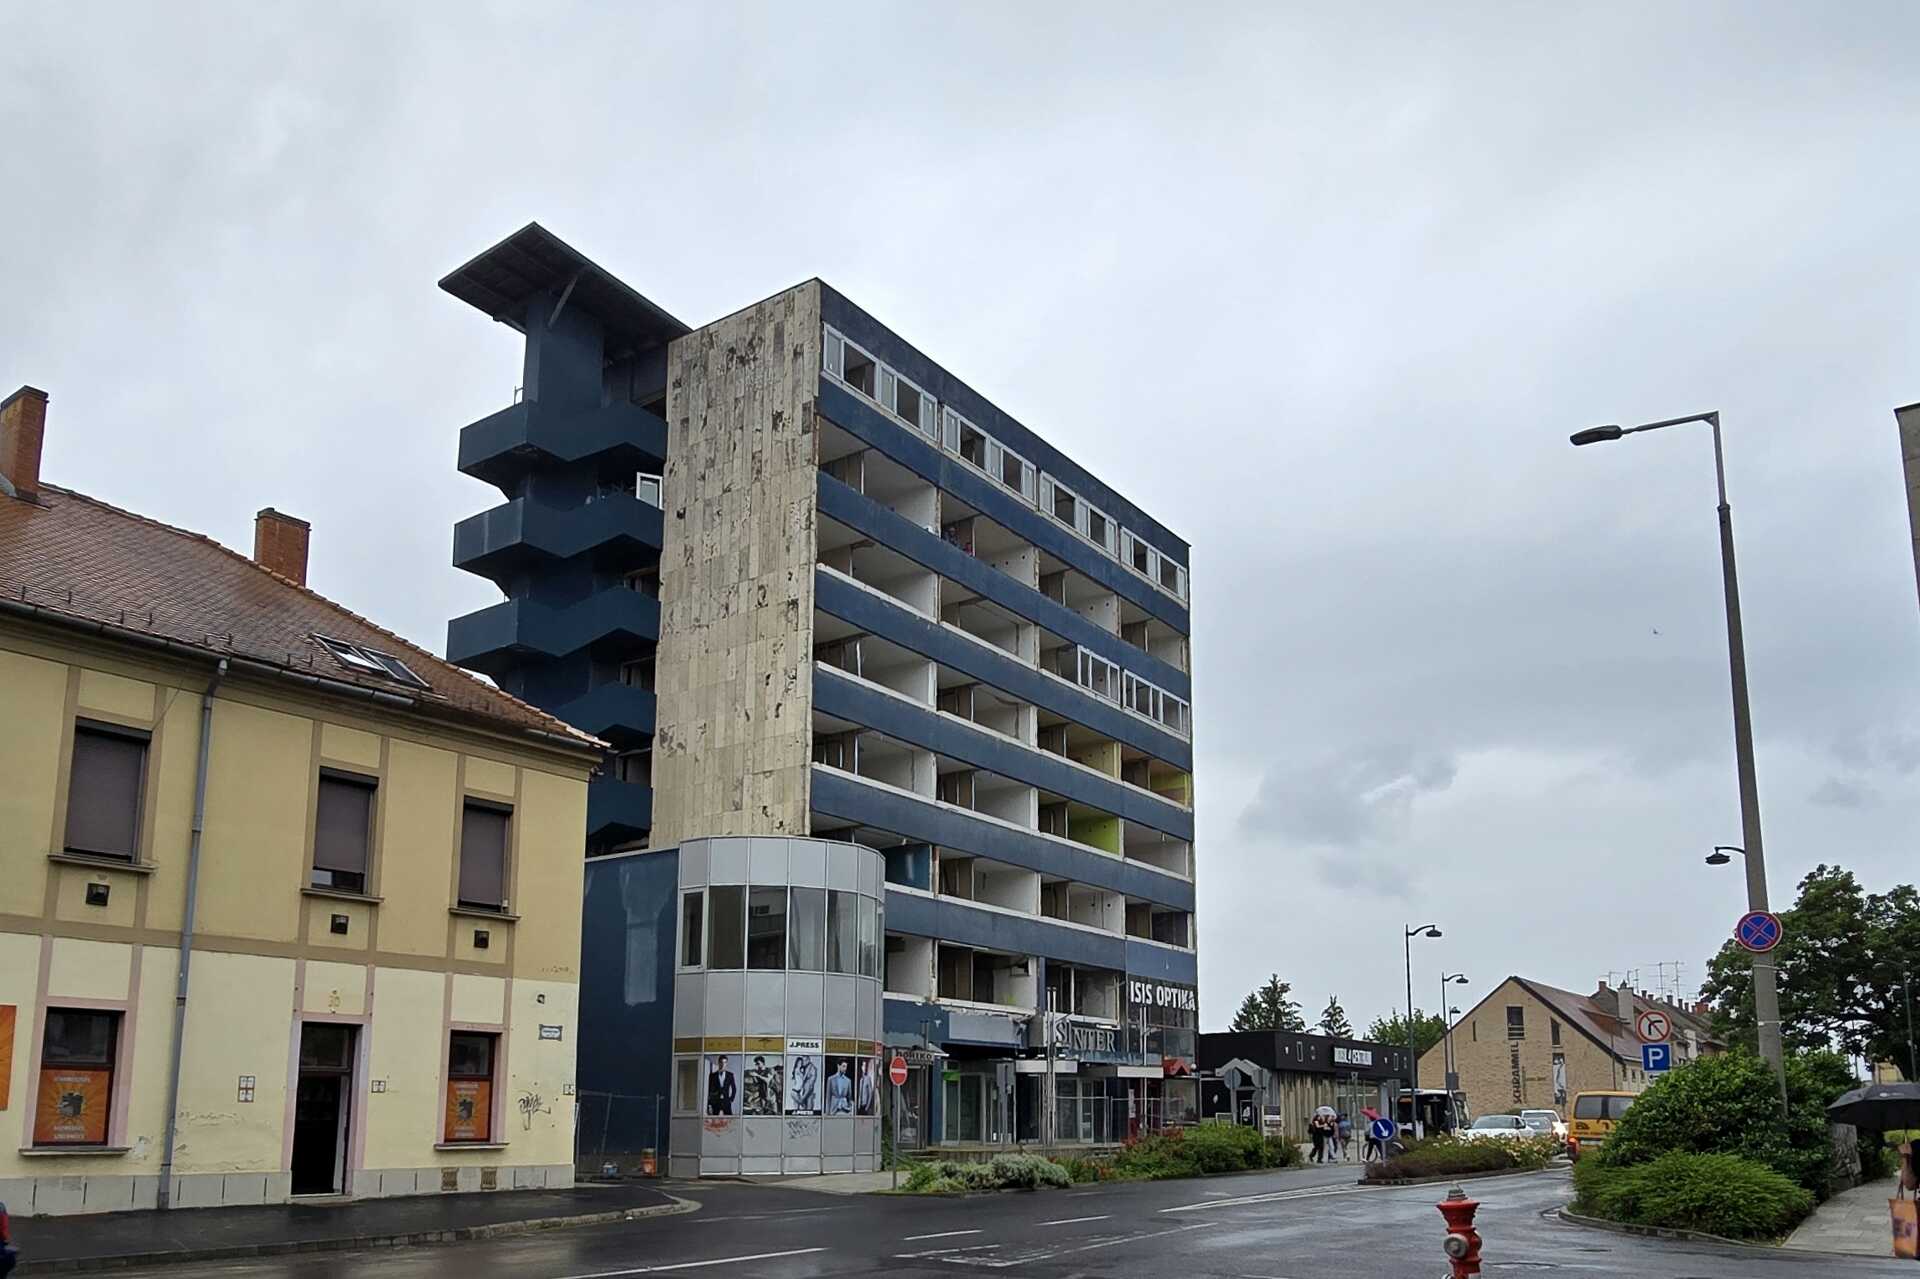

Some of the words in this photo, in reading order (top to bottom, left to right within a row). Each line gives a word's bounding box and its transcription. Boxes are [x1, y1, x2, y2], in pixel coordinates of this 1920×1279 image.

[1130, 980, 1153, 1005] ISIS
[1156, 986, 1196, 1011] OPTIKA
[789, 1041, 820, 1049] J.PRESS
[1647, 1047, 1664, 1069] P
